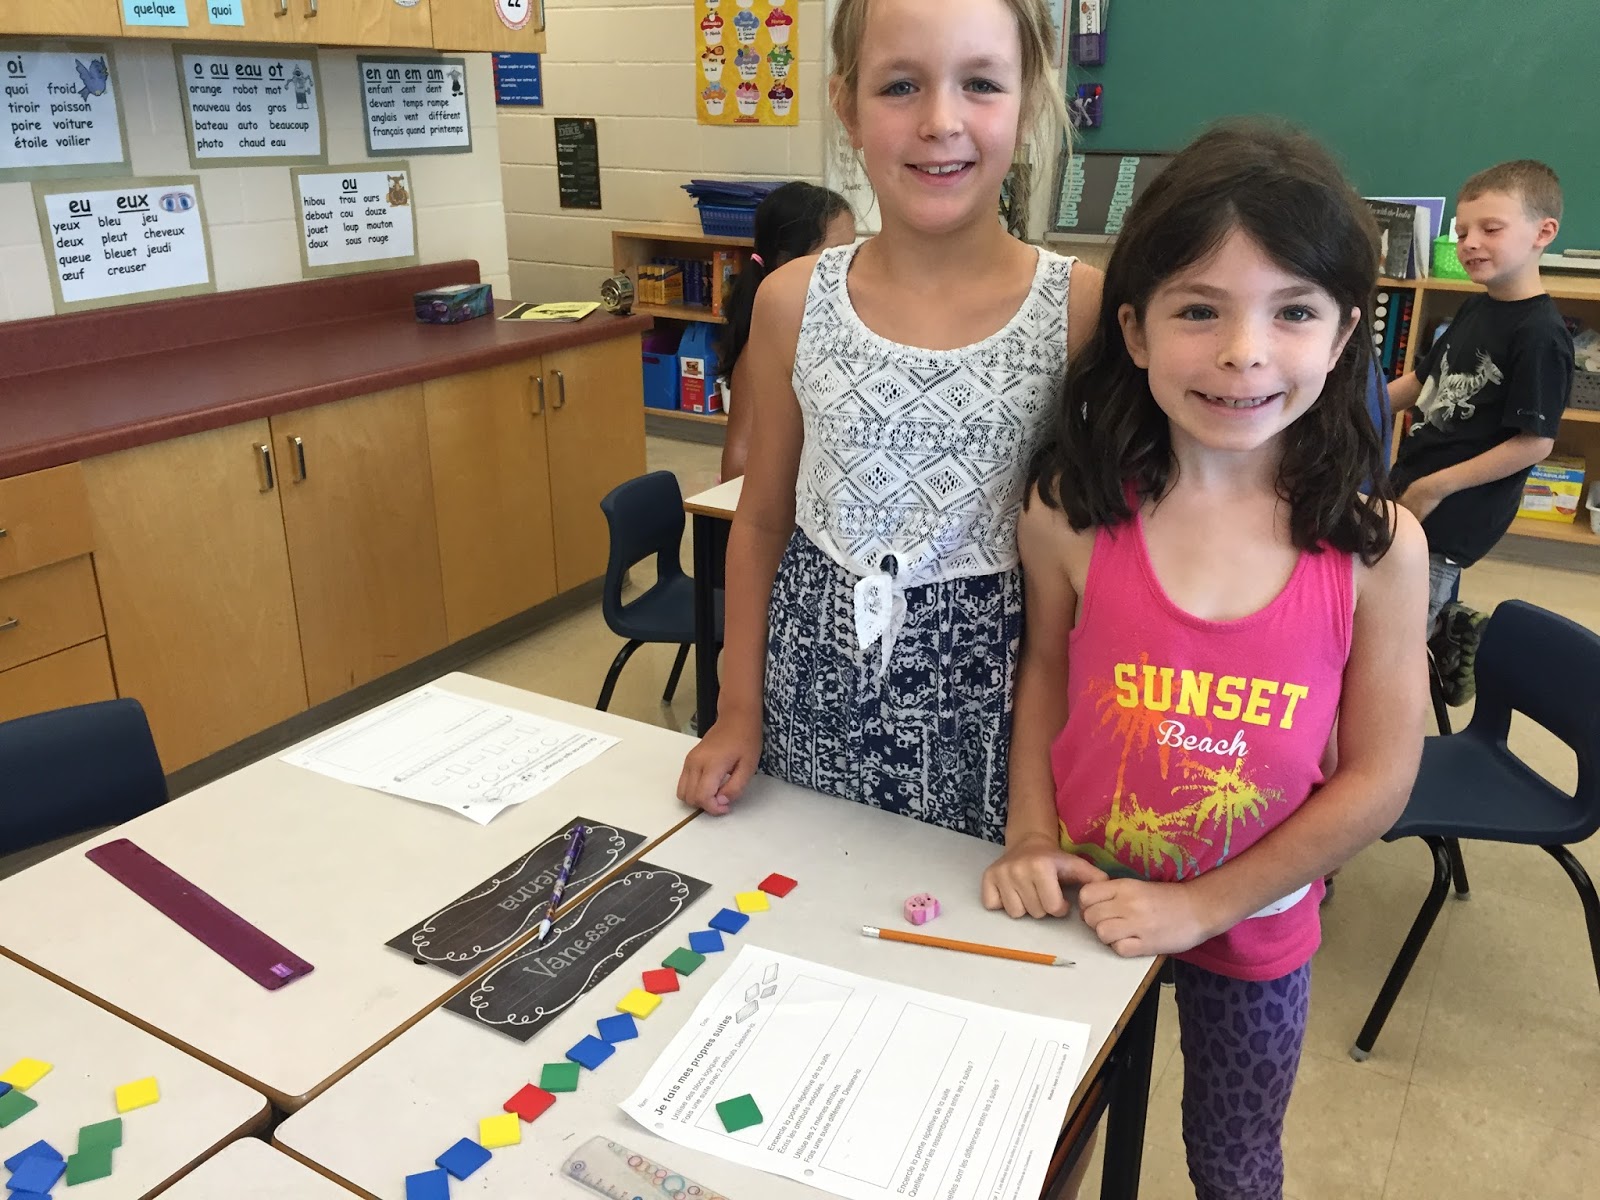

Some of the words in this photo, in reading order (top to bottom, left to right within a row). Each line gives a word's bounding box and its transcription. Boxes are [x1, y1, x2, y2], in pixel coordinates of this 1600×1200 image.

[134, 2, 176, 18] quelque
[212, 4, 232, 18] quoi
[7, 55, 24, 74] oi
[194, 62, 203, 75] o
[210, 63, 228, 76] au
[235, 64, 262, 76] eau
[268, 62, 284, 77] ot
[366, 68, 382, 80] en
[386, 68, 400, 80] an
[404, 67, 422, 80] em
[426, 67, 444, 80] am
[5, 83, 29, 98] quoi
[47, 82, 77, 95] froid
[190, 85, 222, 97] orange
[232, 84, 258, 94] robot
[265, 85, 282, 94] mot
[368, 84, 393, 94] enfant
[401, 85, 416, 94] cent
[426, 84, 442, 94] dent
[8, 102, 40, 114] tiroir
[50, 101, 92, 116] poisson
[192, 103, 230, 112] nouveau
[236, 102, 252, 112] dos
[268, 104, 286, 116] gros
[369, 98, 395, 108] devant
[402, 98, 424, 110] temps
[427, 98, 450, 109] rampe
[371, 112, 398, 124] anglais
[404, 112, 419, 122] vent
[428, 110, 460, 121] différent
[11, 120, 42, 134] poire
[53, 118, 94, 130] voiture
[195, 120, 228, 130] bateau
[238, 120, 258, 130] auto
[270, 120, 310, 132] beaucoup
[372, 126, 404, 137] français
[406, 125, 426, 136] quand
[430, 125, 464, 136] printemps
[14, 136, 48, 149] étoile
[56, 134, 91, 147] voilier
[197, 138, 224, 152] photo
[239, 136, 266, 148] chaud
[270, 138, 286, 147] eau
[342, 178, 357, 190] ou
[69, 198, 91, 213] eu
[116, 194, 150, 209] eux
[304, 196, 326, 206] hibou
[339, 196, 356, 204] trou
[364, 194, 380, 203] ours
[306, 210, 334, 220] debout
[340, 210, 354, 218] cou
[365, 206, 387, 216] douze
[53, 221, 80, 235] yeux
[98, 216, 121, 228] bleu
[142, 213, 158, 226] jeu
[306, 224, 328, 238] jouet
[343, 222, 360, 233] loup
[366, 221, 394, 230] mouton
[56, 236, 84, 248] deux
[101, 232, 128, 246] pleut
[144, 226, 185, 240] cheveux
[308, 239, 328, 249] doux
[346, 237, 362, 246] sous
[368, 234, 389, 245] rouge
[59, 253, 92, 268] queue
[104, 246, 138, 260] bleuet
[146, 242, 172, 258] jeudi
[62, 268, 84, 281] œuf
[108, 262, 146, 276] creuser
[1114, 663, 1309, 730] SUNSET
[1157, 720, 1248, 757] Beach
[523, 912, 626, 978] Vanessa
[654, 1104, 668, 1116] Je
[663, 1084, 681, 1103] fais
[678, 1067, 694, 1084] mes
[691, 1038, 716, 1068] propres
[712, 1014, 732, 1038] suites
[671, 1100, 688, 1121] Utilise
[686, 1090, 696, 1102] des
[692, 1077, 706, 1092] blocs
[680, 1110, 694, 1124] Fais
[692, 1099, 702, 1110] une
[700, 1086, 712, 1099] suite
[709, 1074, 720, 1086] avec
[950, 1093, 961, 1107] entre
[767, 1126, 788, 1152] Encercle
[788, 1103, 800, 1120] partie
[798, 1079, 816, 1104] répétitive
[812, 1072, 820, 1080] de
[978, 1112, 988, 1128] entre
[777, 1139, 792, 1154] Écris
[787, 1130, 797, 1140] les
[794, 1106, 811, 1130] attributs
[793, 1140, 809, 1160] Utilise
[804, 1131, 814, 1141] les
[814, 1105, 829, 1126] mêmes
[932, 1106, 954, 1148] ressemblances
[804, 1150, 816, 1164] Fais
[813, 1137, 823, 1150] une
[820, 1122, 832, 1138] suite
[897, 1165, 916, 1194] Encercle
[915, 1141, 926, 1160] partie
[934, 1107, 942, 1115] de
[964, 1127, 982, 1159] différences
[926, 1148, 936, 1159] les
[922, 1158, 931, 1173] sont
[960, 1159, 969, 1169] les
[954, 1168, 964, 1183] sont
[908, 1172, 926, 1198] Quelles
